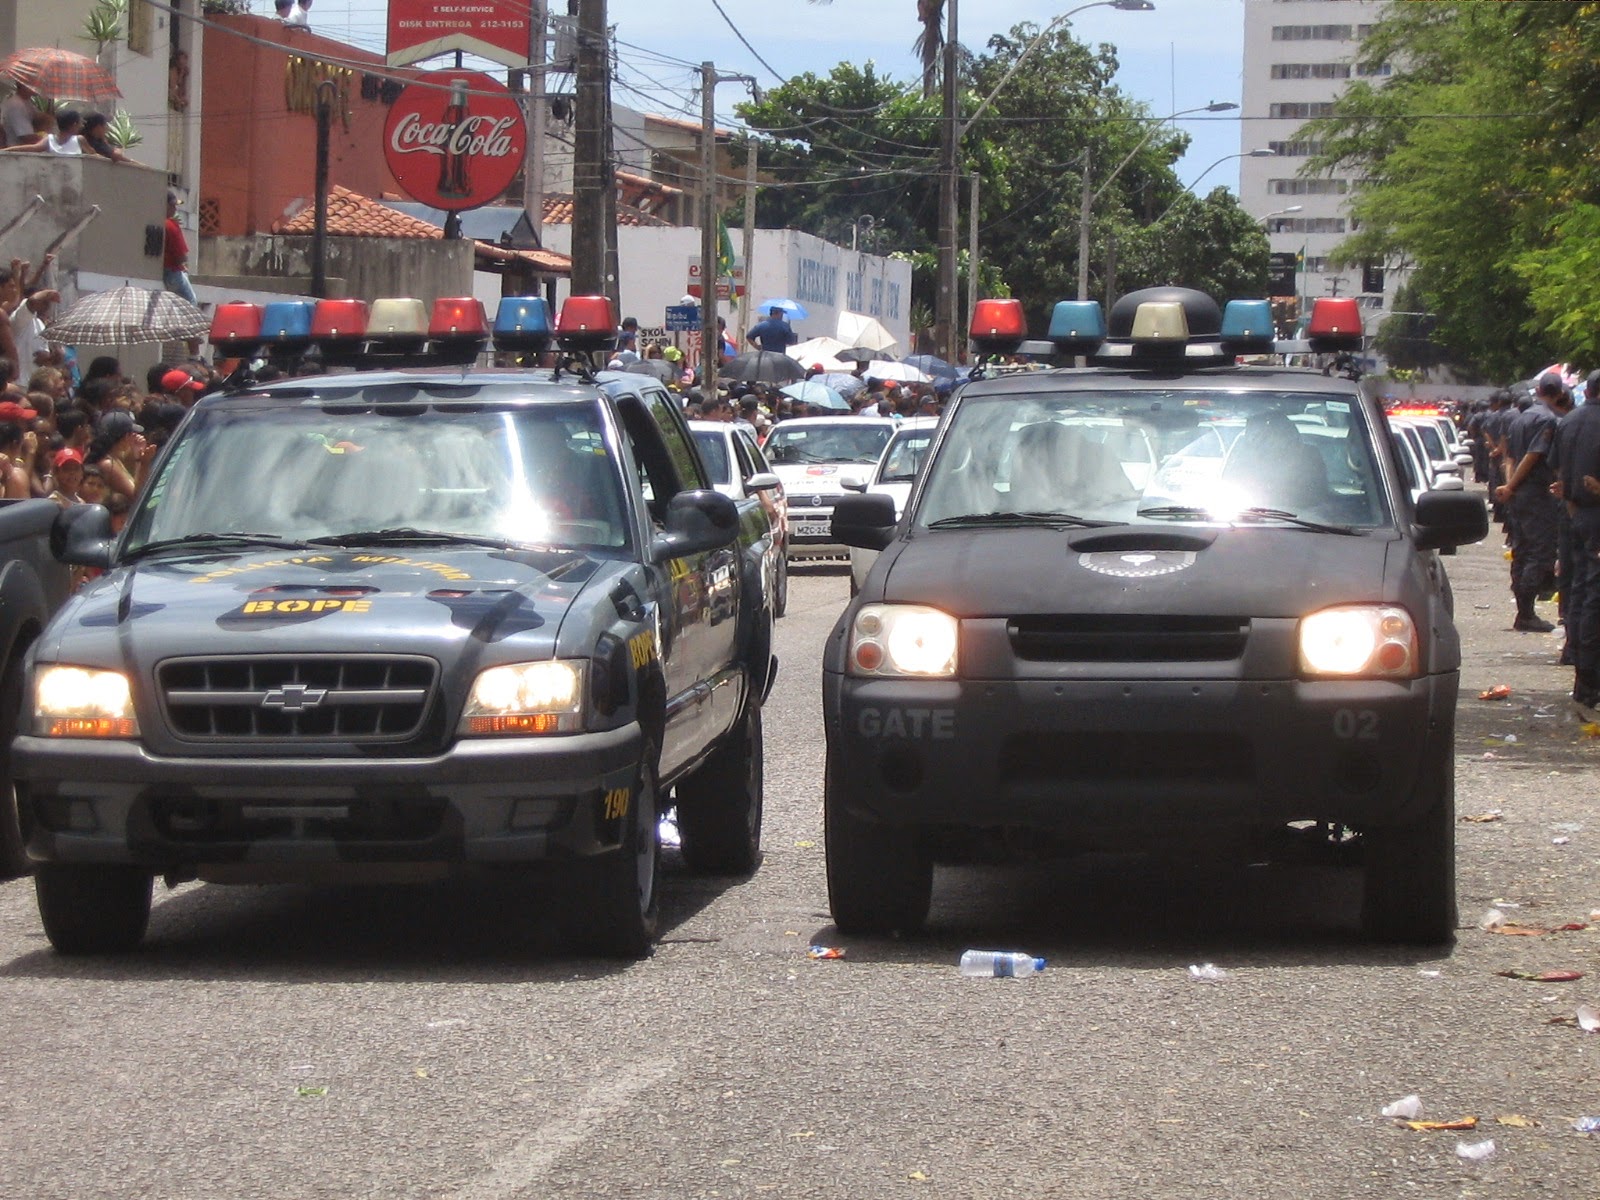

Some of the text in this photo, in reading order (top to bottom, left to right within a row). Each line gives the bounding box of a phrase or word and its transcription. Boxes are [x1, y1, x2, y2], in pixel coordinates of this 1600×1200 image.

[399, 20, 423, 28] DISK
[425, 20, 473, 28] ENTREGA
[641, 328, 666, 337] SKOL
[797, 526, 831, 535] MZC-245
[242, 600, 372, 614] BOPE
[858, 707, 955, 738] GATE
[1333, 708, 1379, 740] 02
[604, 787, 630, 820] 190
